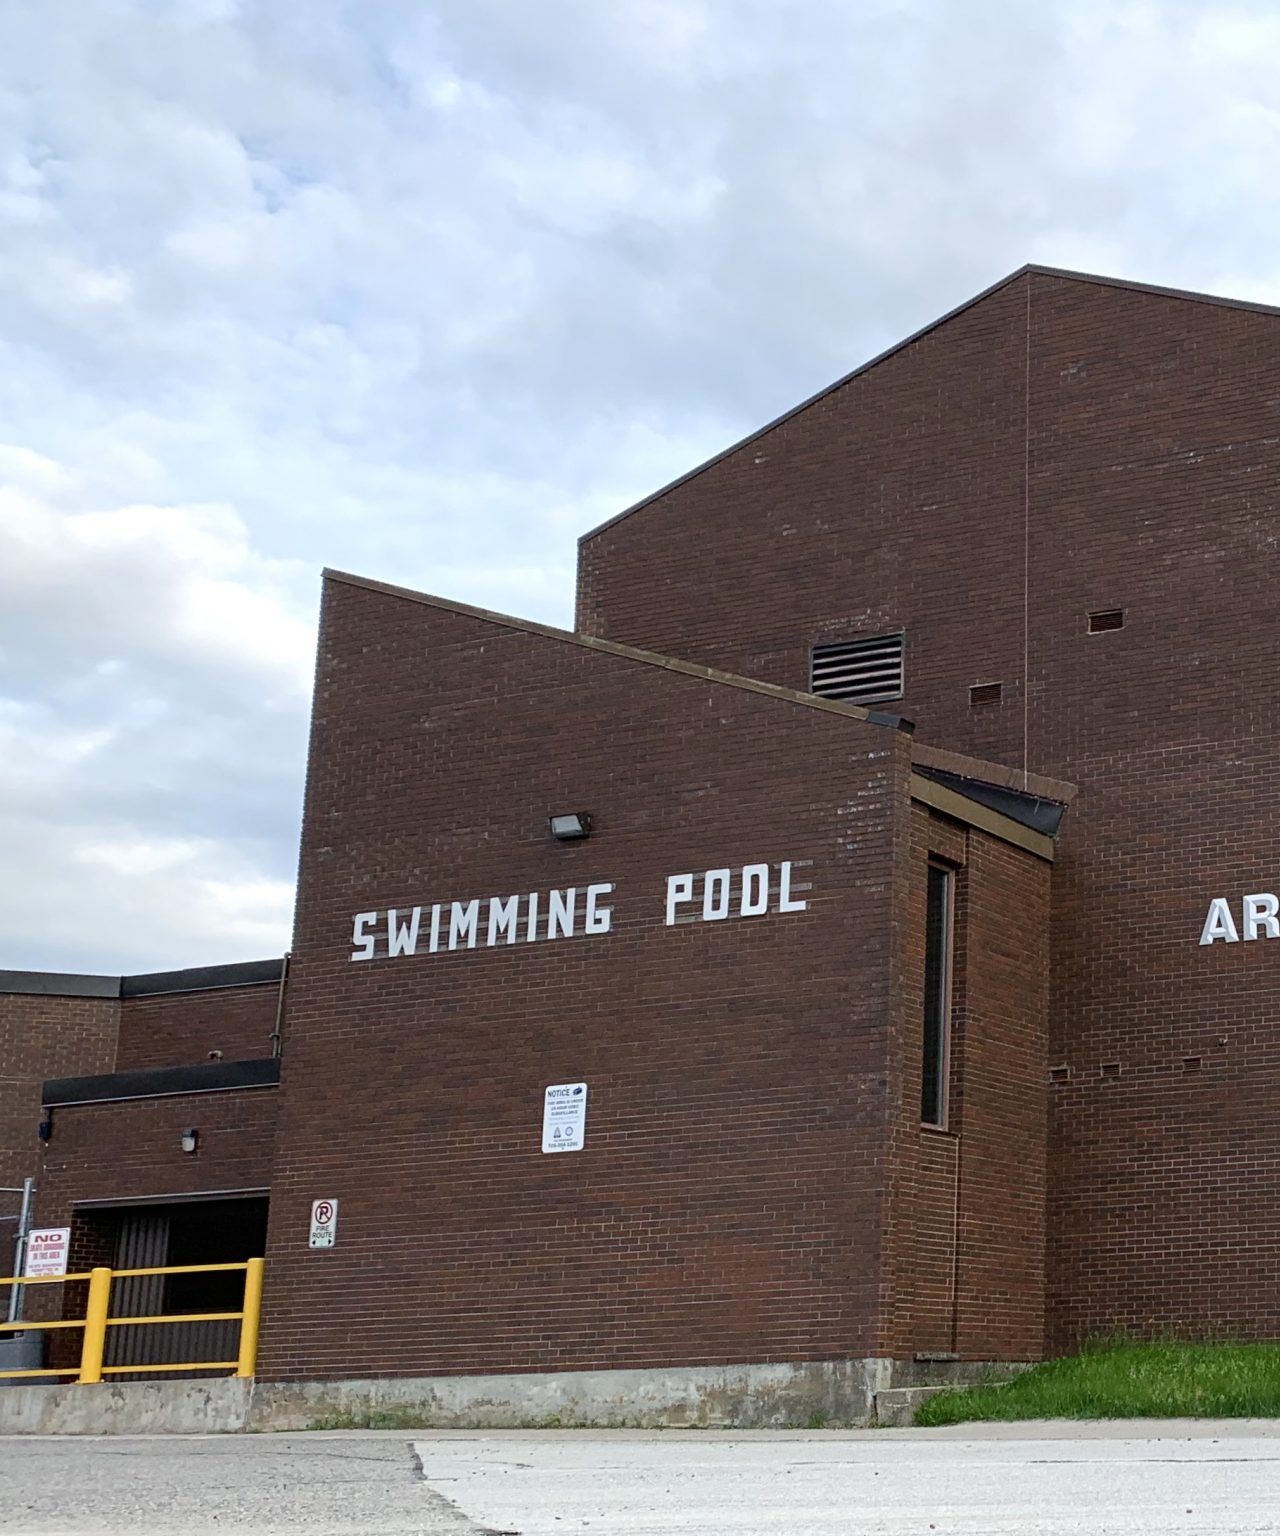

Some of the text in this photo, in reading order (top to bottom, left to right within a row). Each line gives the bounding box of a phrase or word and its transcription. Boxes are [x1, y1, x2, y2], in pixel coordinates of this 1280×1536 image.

[350, 861, 807, 961] SWIMMING POOL
[547, 1088, 570, 1098] NOTICE
[35, 1234, 62, 1243] NO
[312, 1231, 333, 1239] ROUTE
